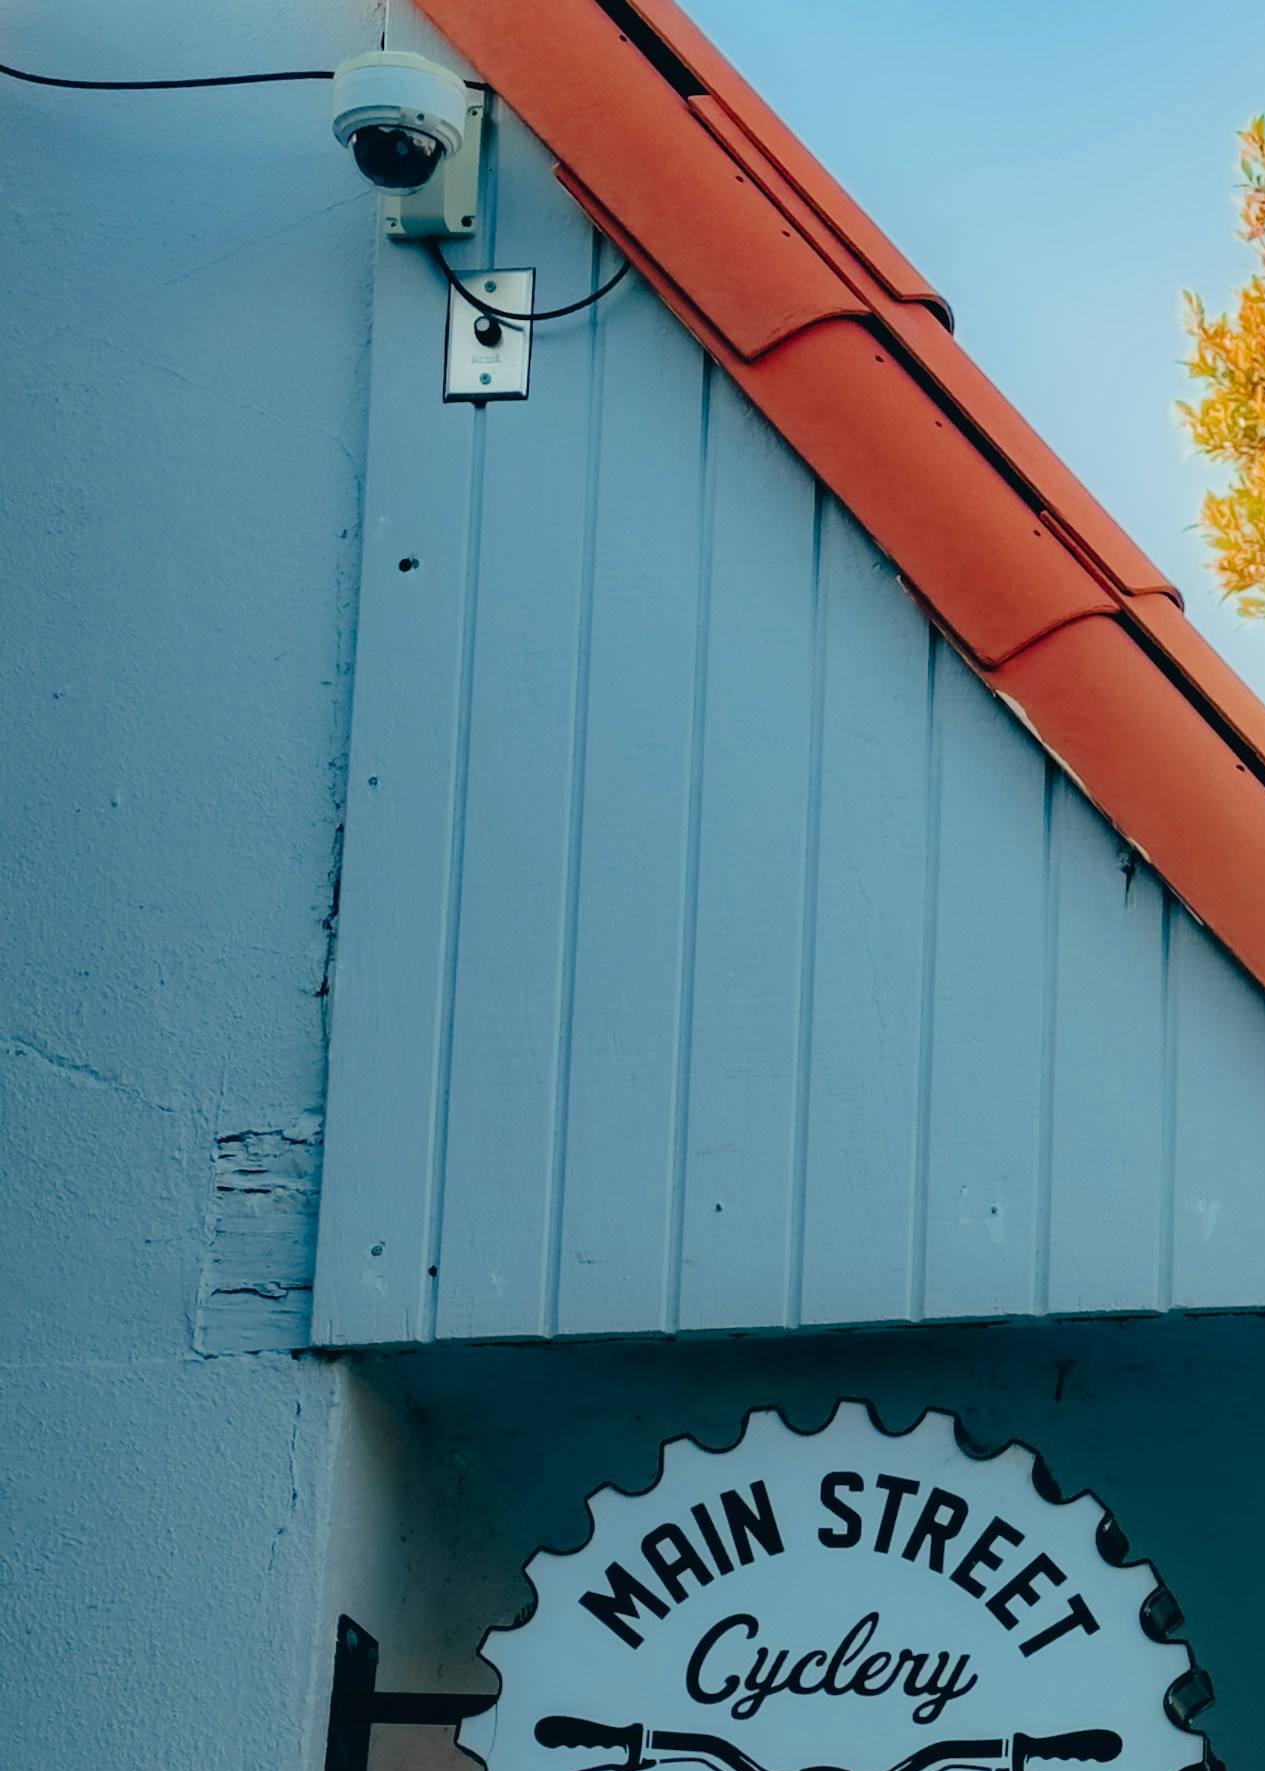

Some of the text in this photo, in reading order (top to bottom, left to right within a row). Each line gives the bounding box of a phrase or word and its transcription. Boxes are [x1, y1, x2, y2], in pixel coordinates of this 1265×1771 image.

[578, 1471, 1100, 1657] MAIN STREET
[686, 1611, 978, 1726] Cyclery
